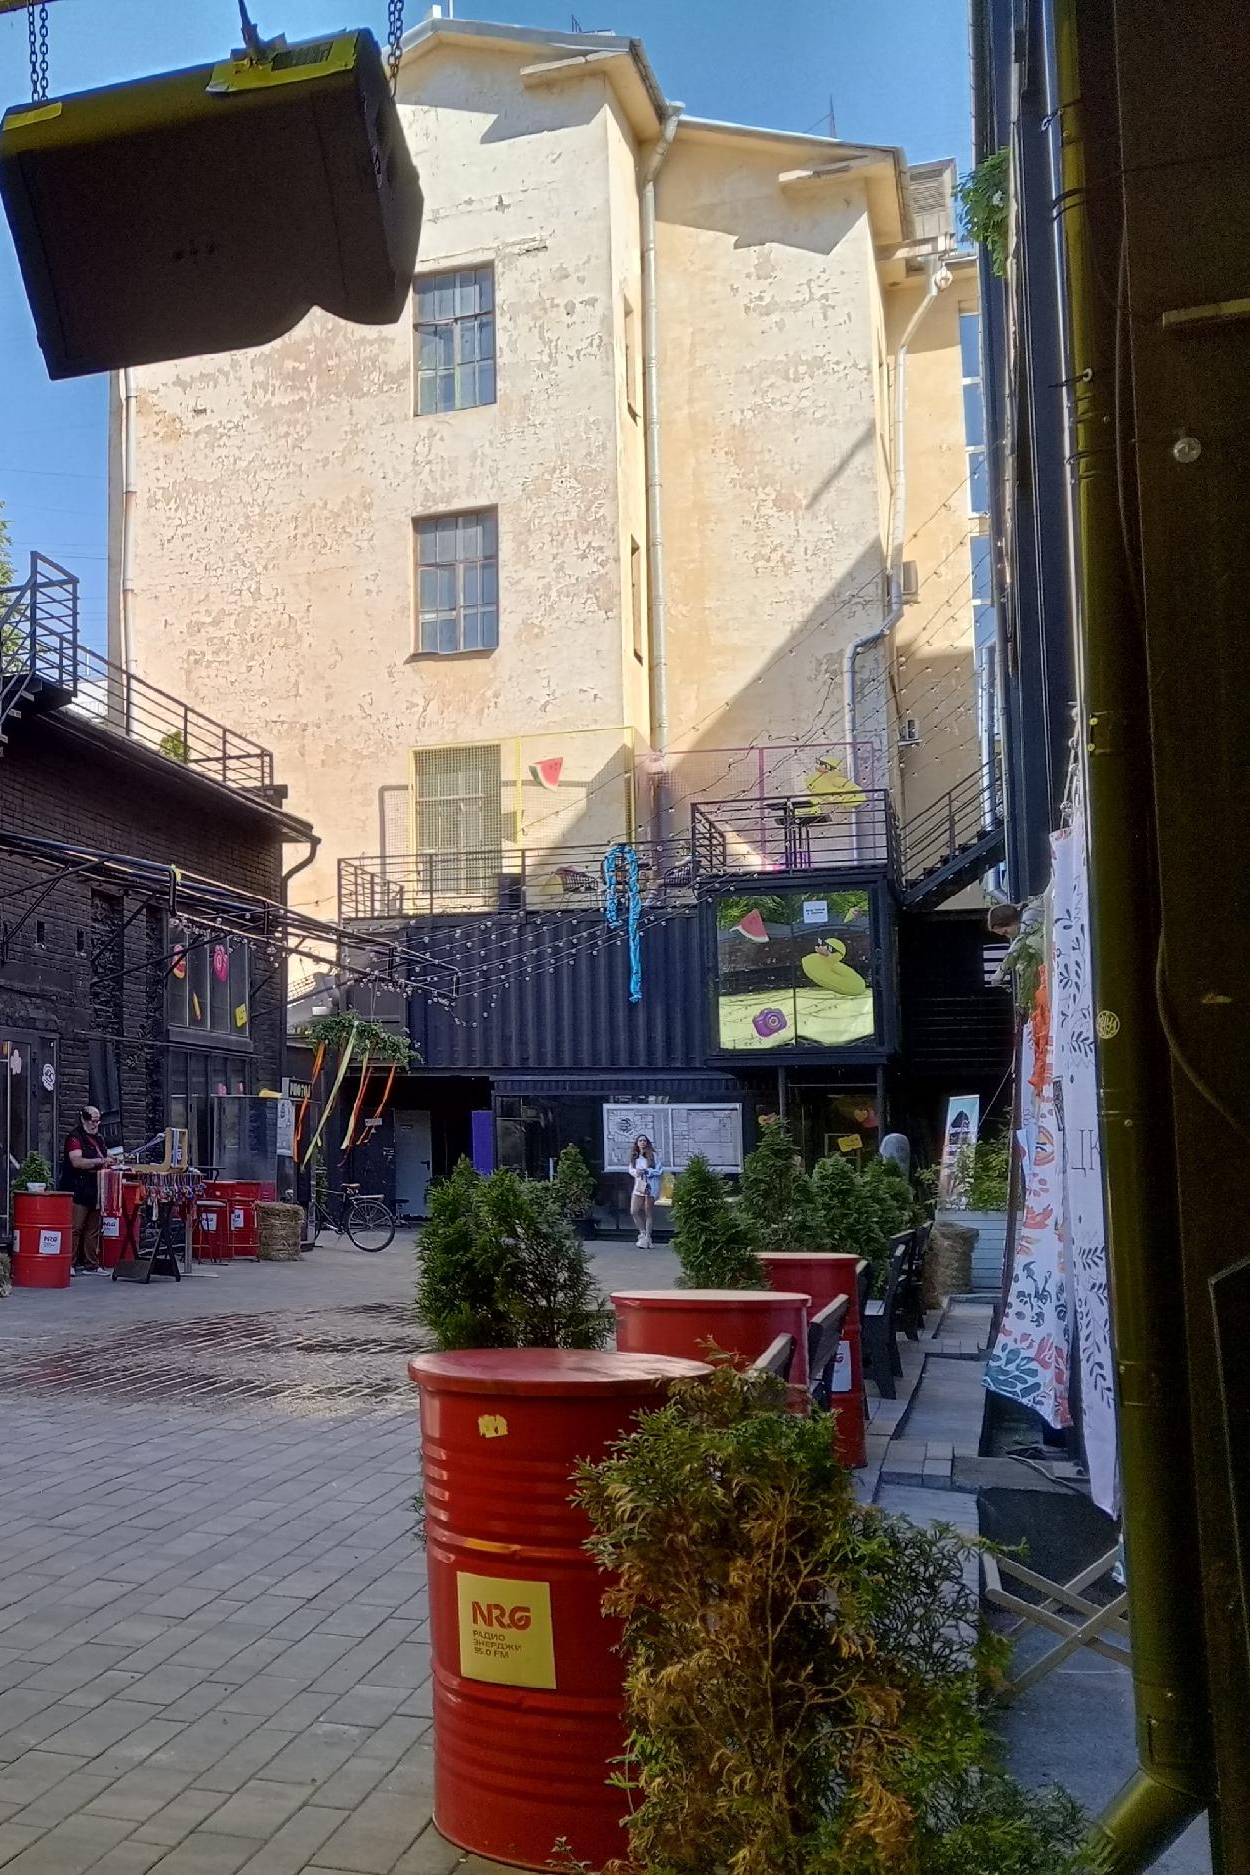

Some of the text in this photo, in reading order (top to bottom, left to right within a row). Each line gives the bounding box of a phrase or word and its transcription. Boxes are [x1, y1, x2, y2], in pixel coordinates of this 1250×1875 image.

[471, 1600, 532, 1631] NRG
[473, 1630, 506, 1642] РАДИО
[472, 1638, 522, 1652] ЭНЕРДЖИ
[493, 1649, 510, 1659] FM
